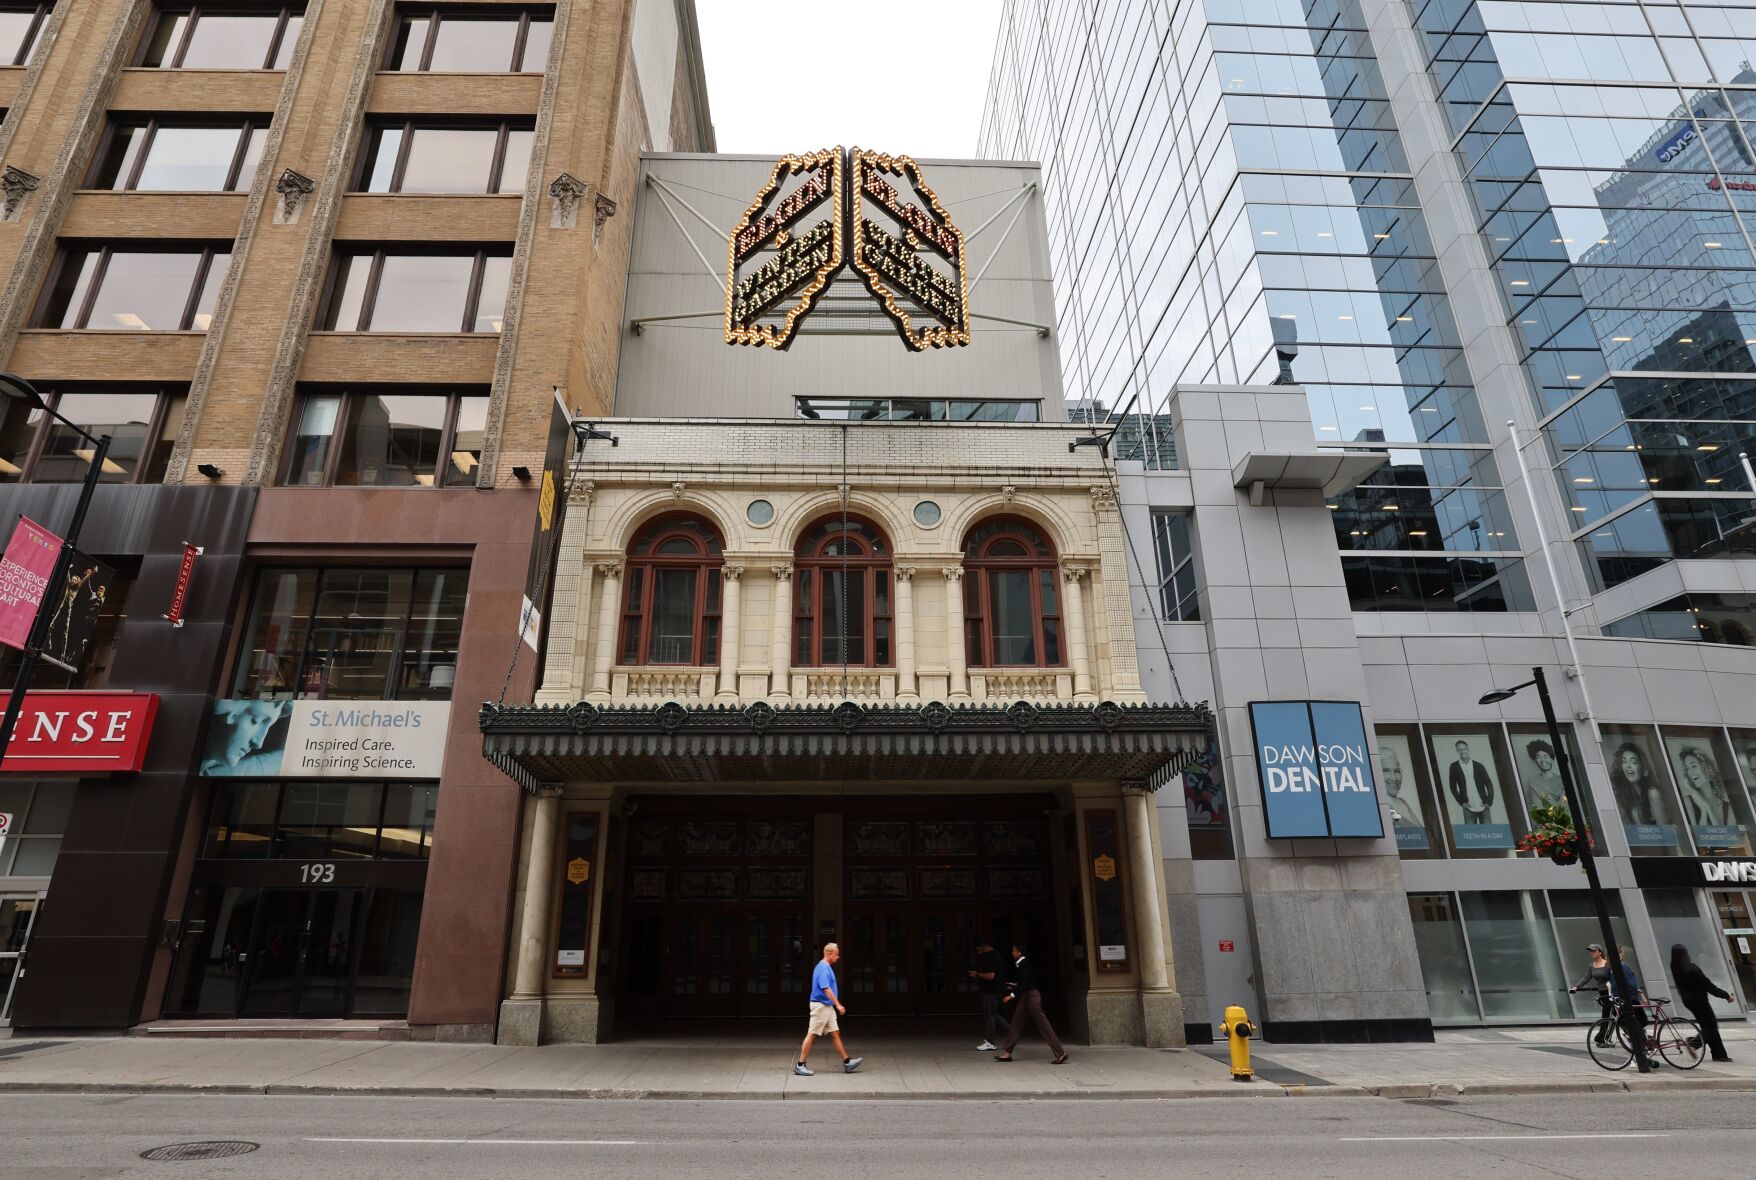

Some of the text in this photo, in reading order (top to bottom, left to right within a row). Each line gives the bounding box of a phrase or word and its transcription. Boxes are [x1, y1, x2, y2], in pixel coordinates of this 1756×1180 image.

[775, 231, 790, 249] &
[737, 220, 832, 298] WINTER
[867, 218, 959, 302] WINTER
[735, 241, 830, 321] GARDEN
[864, 244, 959, 323] GARDEN
[0, 558, 49, 588] EXPERIENCE
[0, 568, 45, 597] ORONTO'S
[170, 548, 194, 617] HOMESENSE
[0, 591, 20, 607] ART
[309, 709, 421, 728] St. Michael's
[305, 738, 395, 755] Inspired Care.
[1263, 744, 1364, 764] DAWSON
[301, 755, 416, 771] Inspiring Science.
[1266, 766, 1371, 793] DENTAL
[300, 863, 336, 883] 193
